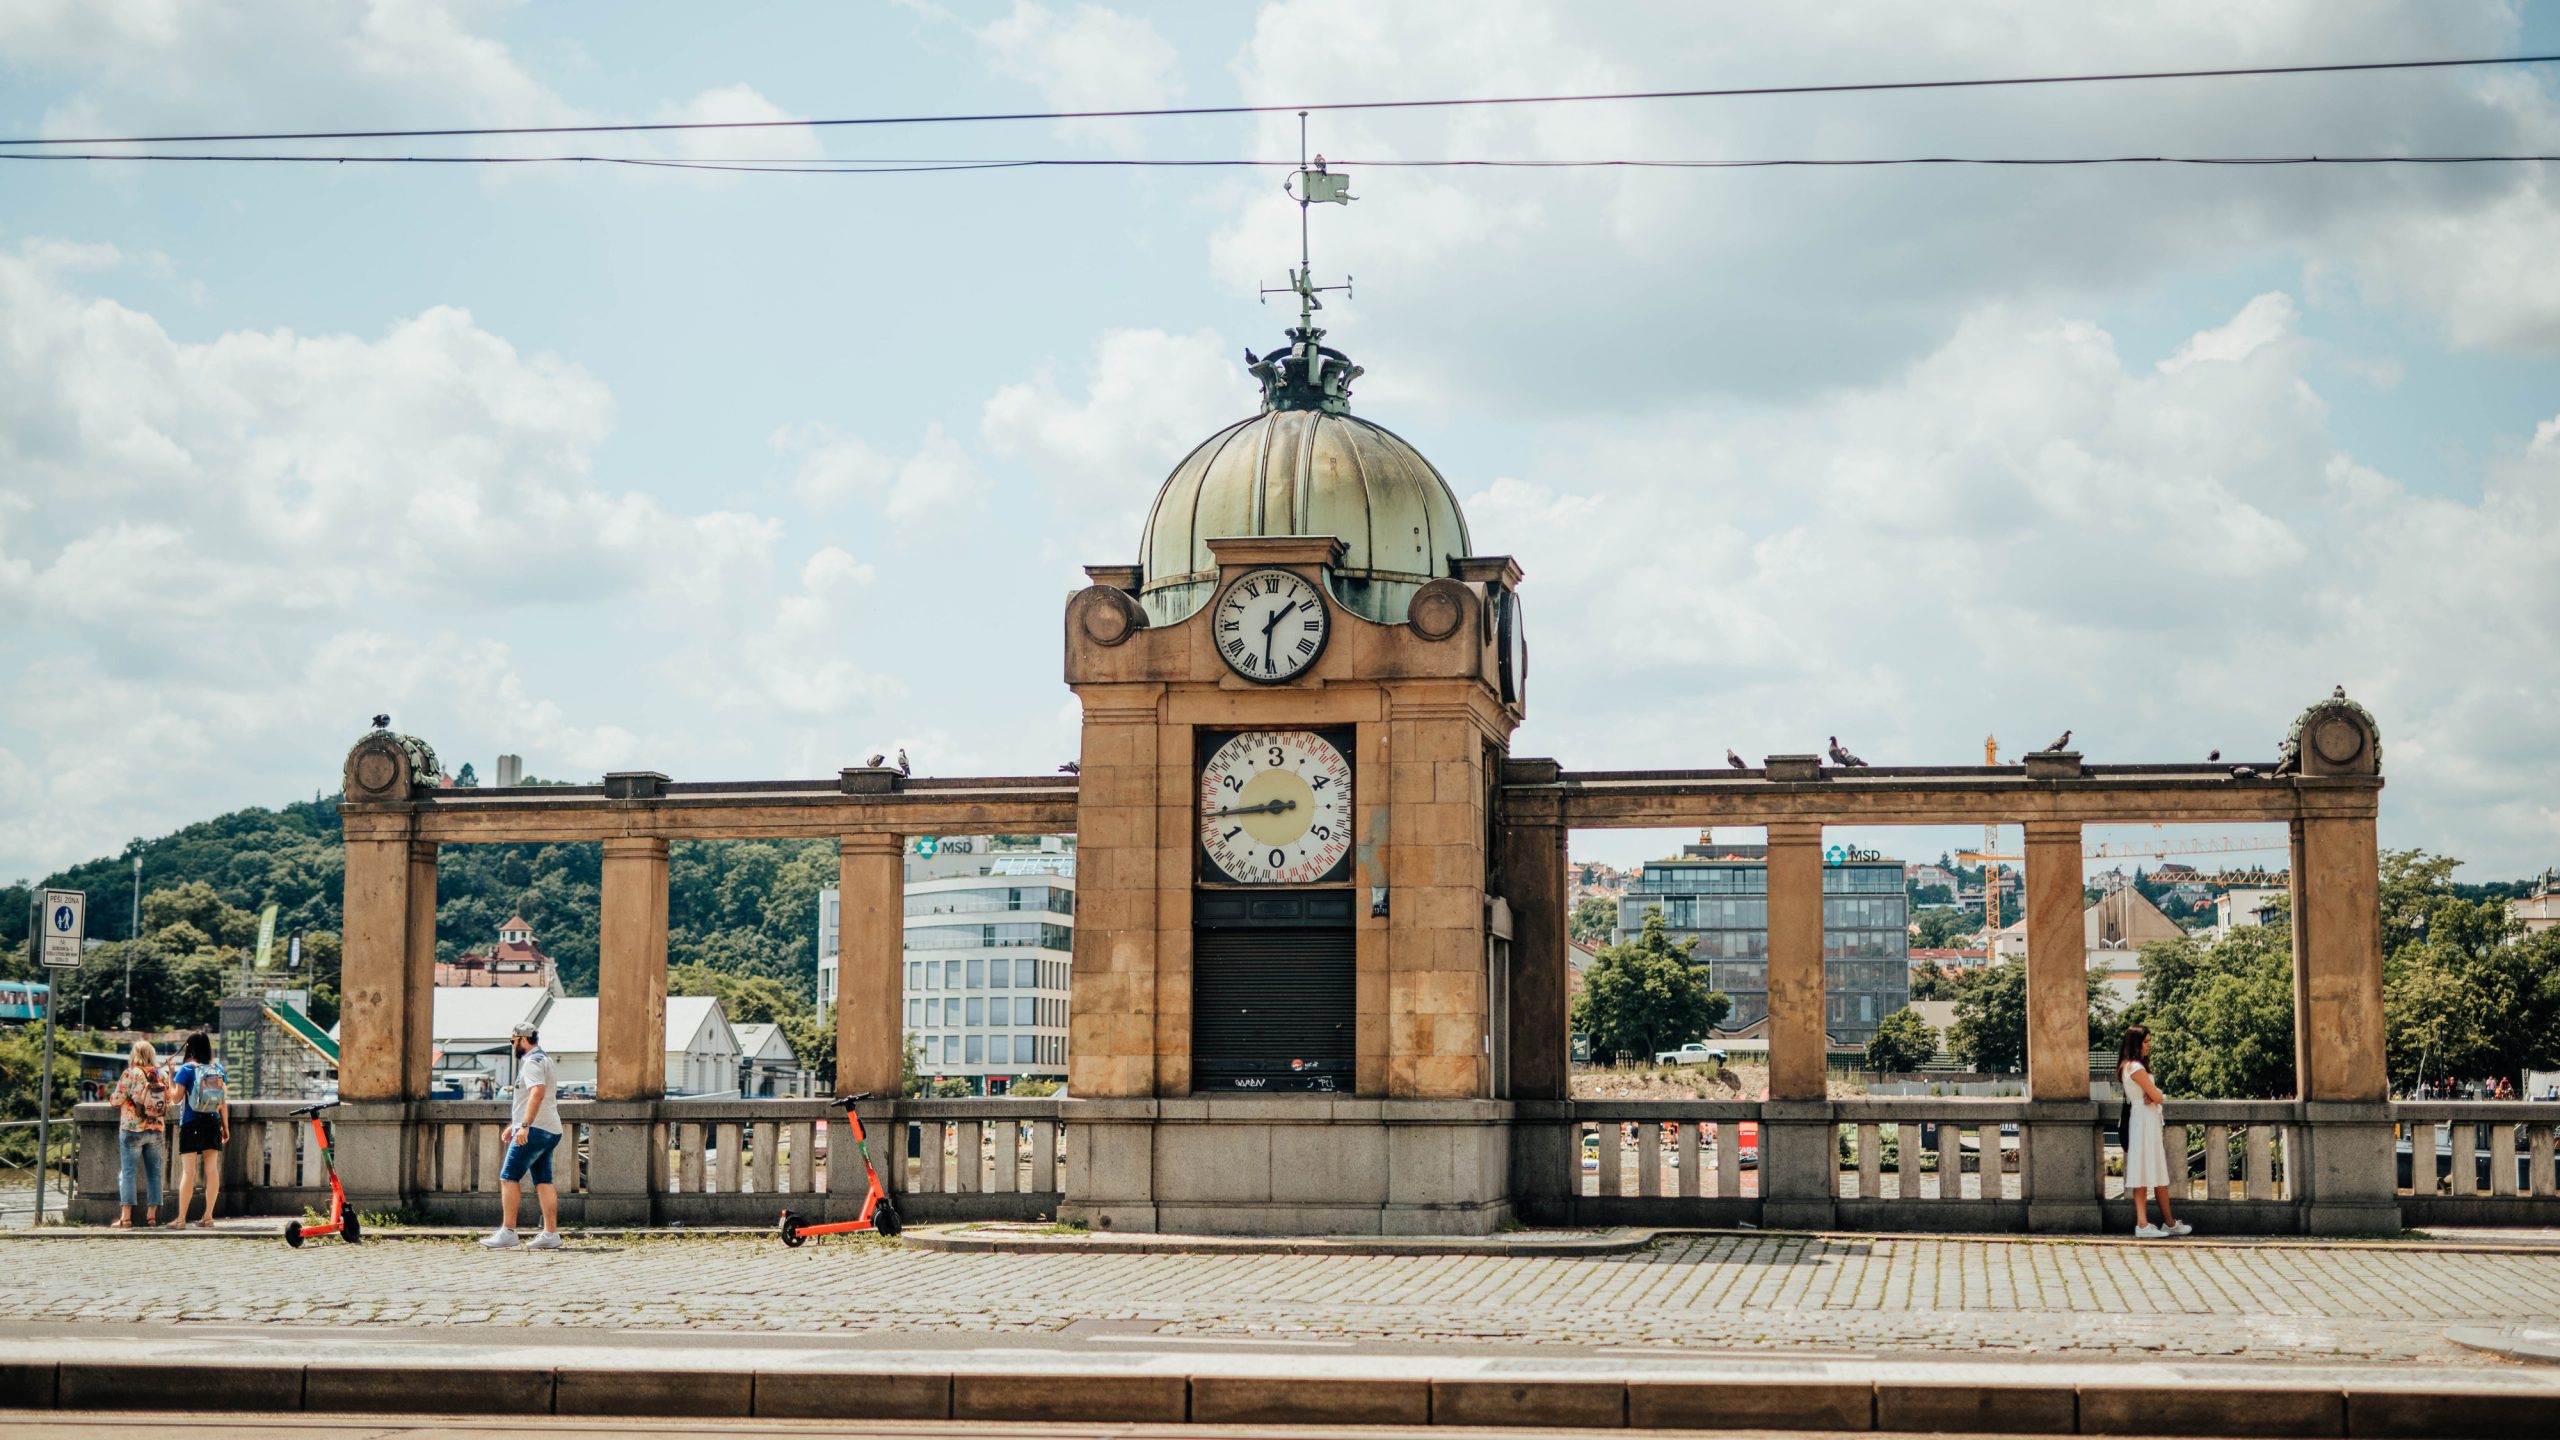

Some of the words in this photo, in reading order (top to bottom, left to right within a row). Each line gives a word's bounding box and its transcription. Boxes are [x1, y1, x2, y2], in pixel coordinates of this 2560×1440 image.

[1245, 582, 1260, 600] XI
[1265, 579, 1280, 593] XII
[1287, 584, 1298, 598] I
[1229, 600, 1245, 614] X
[1299, 600, 1315, 613] II
[1224, 620, 1239, 631] IX
[1304, 620, 1319, 631] III
[1227, 637, 1245, 658] VIII
[1242, 652, 1258, 671] VII
[1287, 654, 1298, 670] V
[1268, 747, 1284, 767] 3
[1223, 774, 1244, 793] 2
[1312, 775, 1331, 791] 4
[1223, 826, 1242, 842] 1
[1310, 824, 1330, 841] 5
[942, 842, 973, 854] MSD
[1850, 850, 1880, 862] MSD
[1268, 849, 1285, 868] 0
